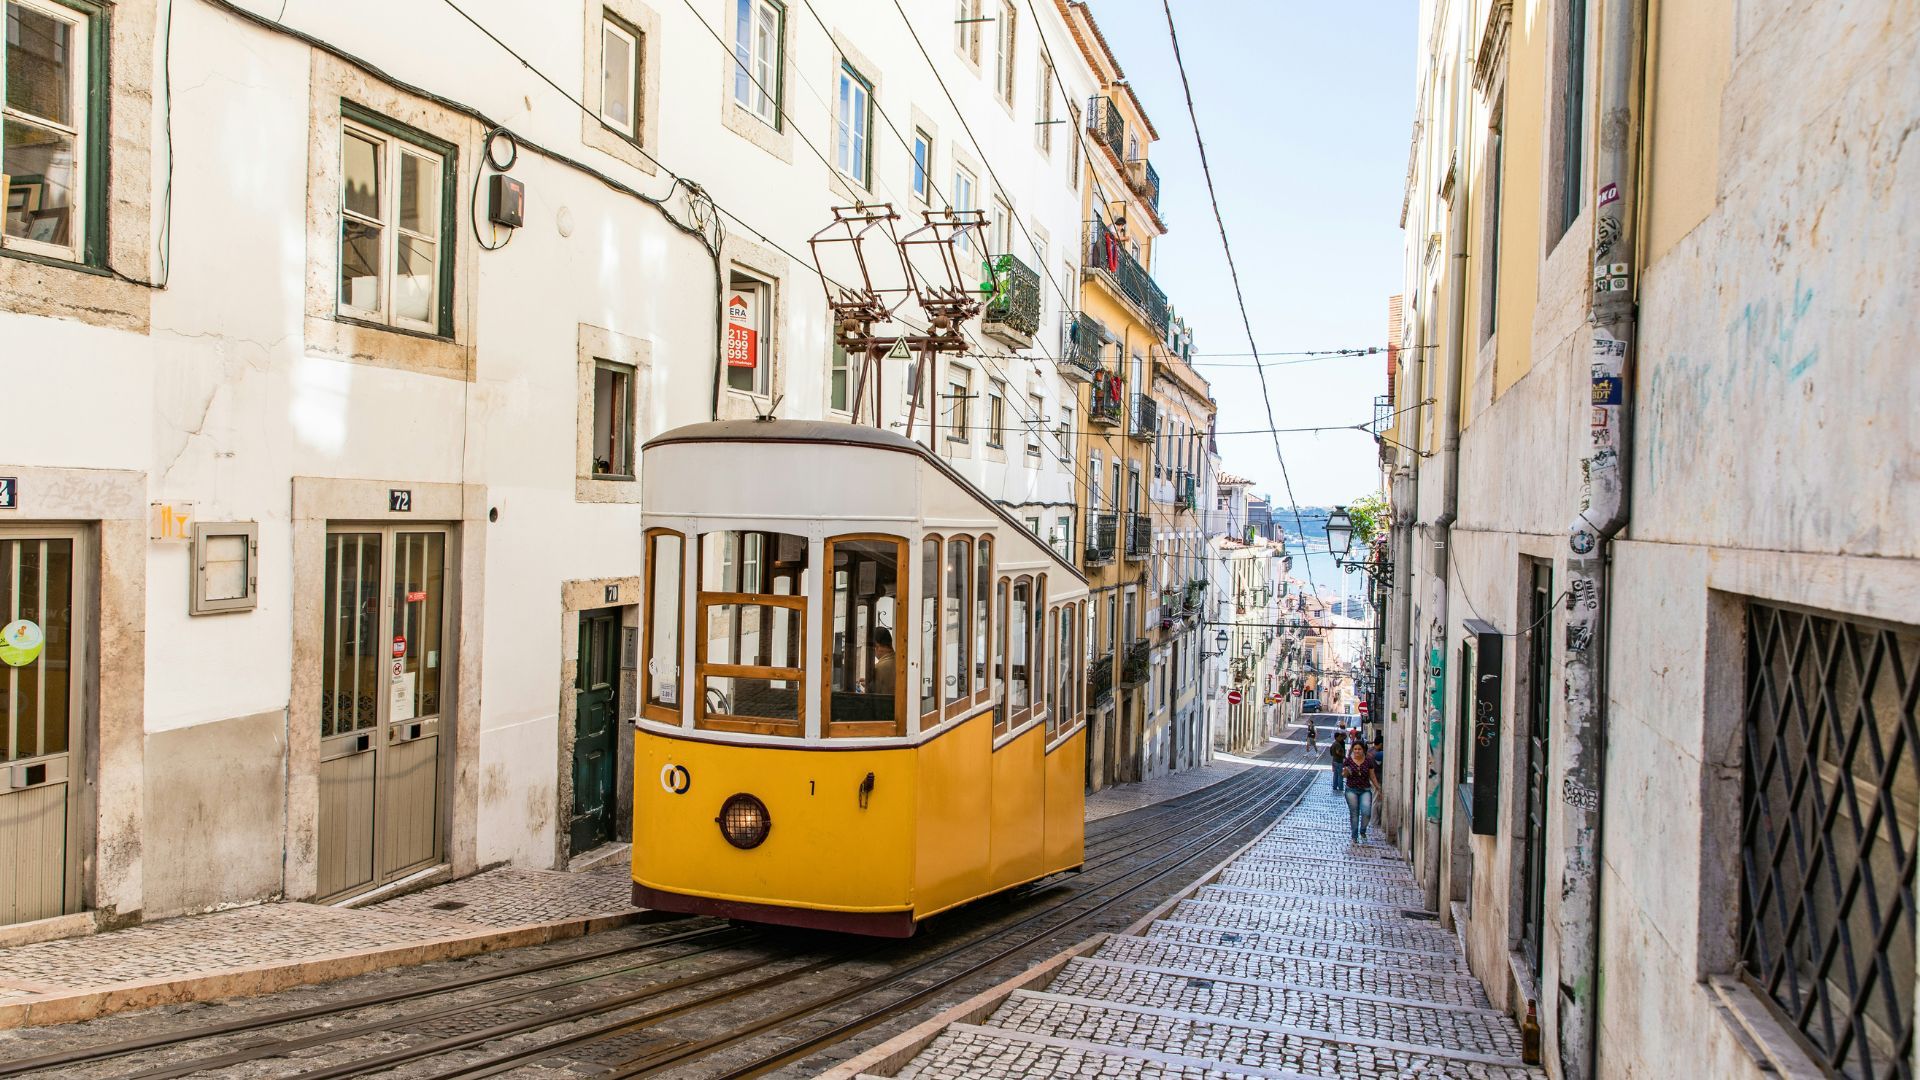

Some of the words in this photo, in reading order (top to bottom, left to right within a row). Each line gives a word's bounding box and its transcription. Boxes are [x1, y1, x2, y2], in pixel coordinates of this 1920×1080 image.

[730, 308, 747, 317] ERA
[729, 329, 748, 340] 215
[729, 339, 748, 350] 999
[729, 349, 748, 360] 995
[394, 491, 409, 510] 72
[609, 586, 618, 601] 70
[809, 780, 815, 796] 1
